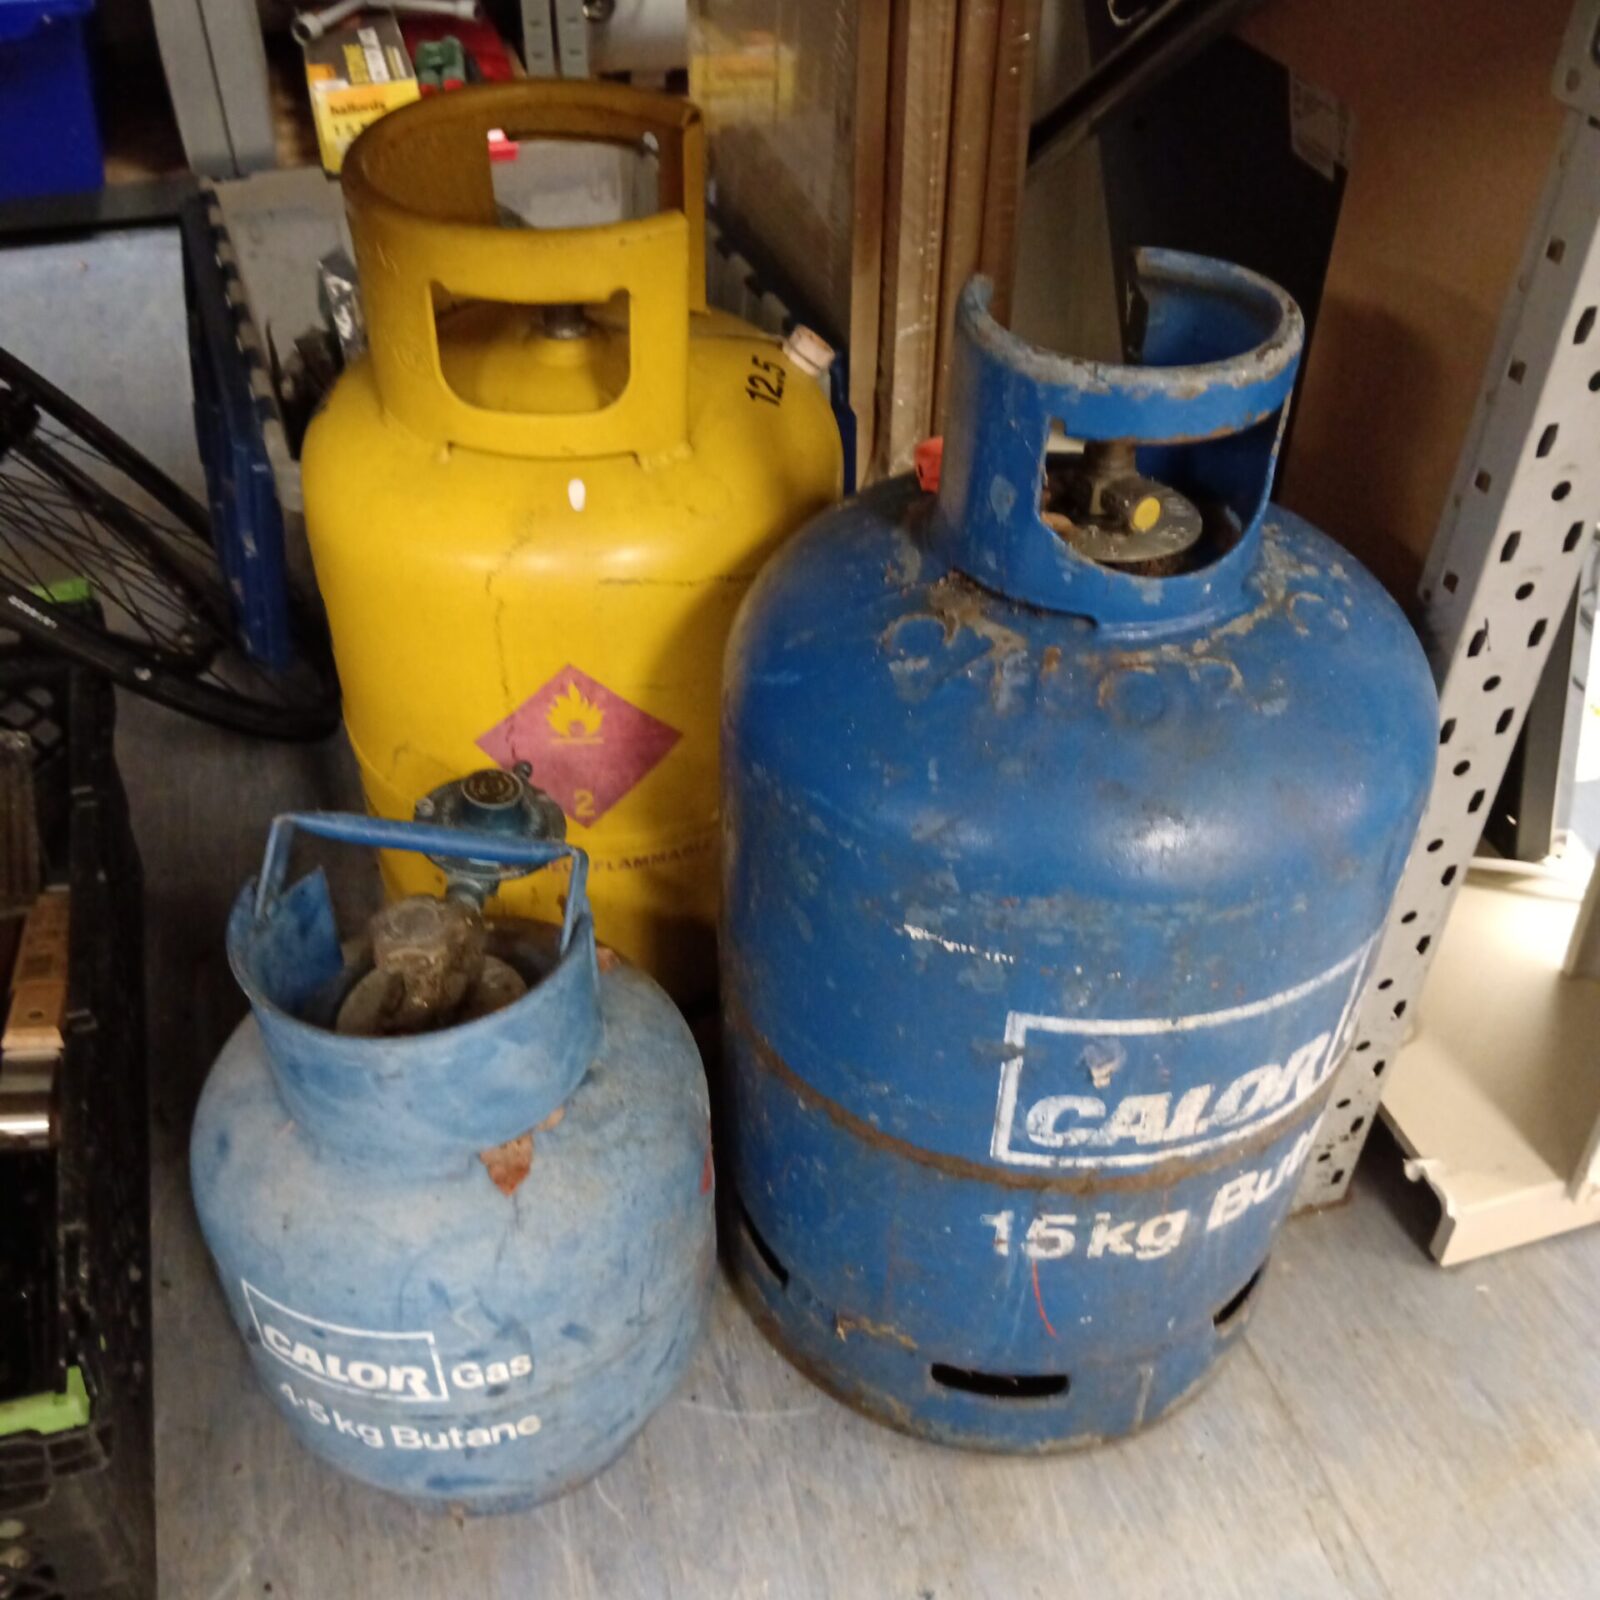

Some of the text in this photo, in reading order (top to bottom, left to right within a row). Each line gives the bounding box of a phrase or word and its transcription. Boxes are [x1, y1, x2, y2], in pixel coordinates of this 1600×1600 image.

[745, 354, 785, 407] 12.5
[573, 789, 595, 816] 2
[1026, 1031, 1331, 1148] CALOR
[980, 1209, 1076, 1261] 15
[1087, 1209, 1190, 1261] kg
[264, 1325, 532, 1400] CALOR Gas
[333, 1410, 384, 1450] kg
[391, 1414, 543, 1451] Butane
